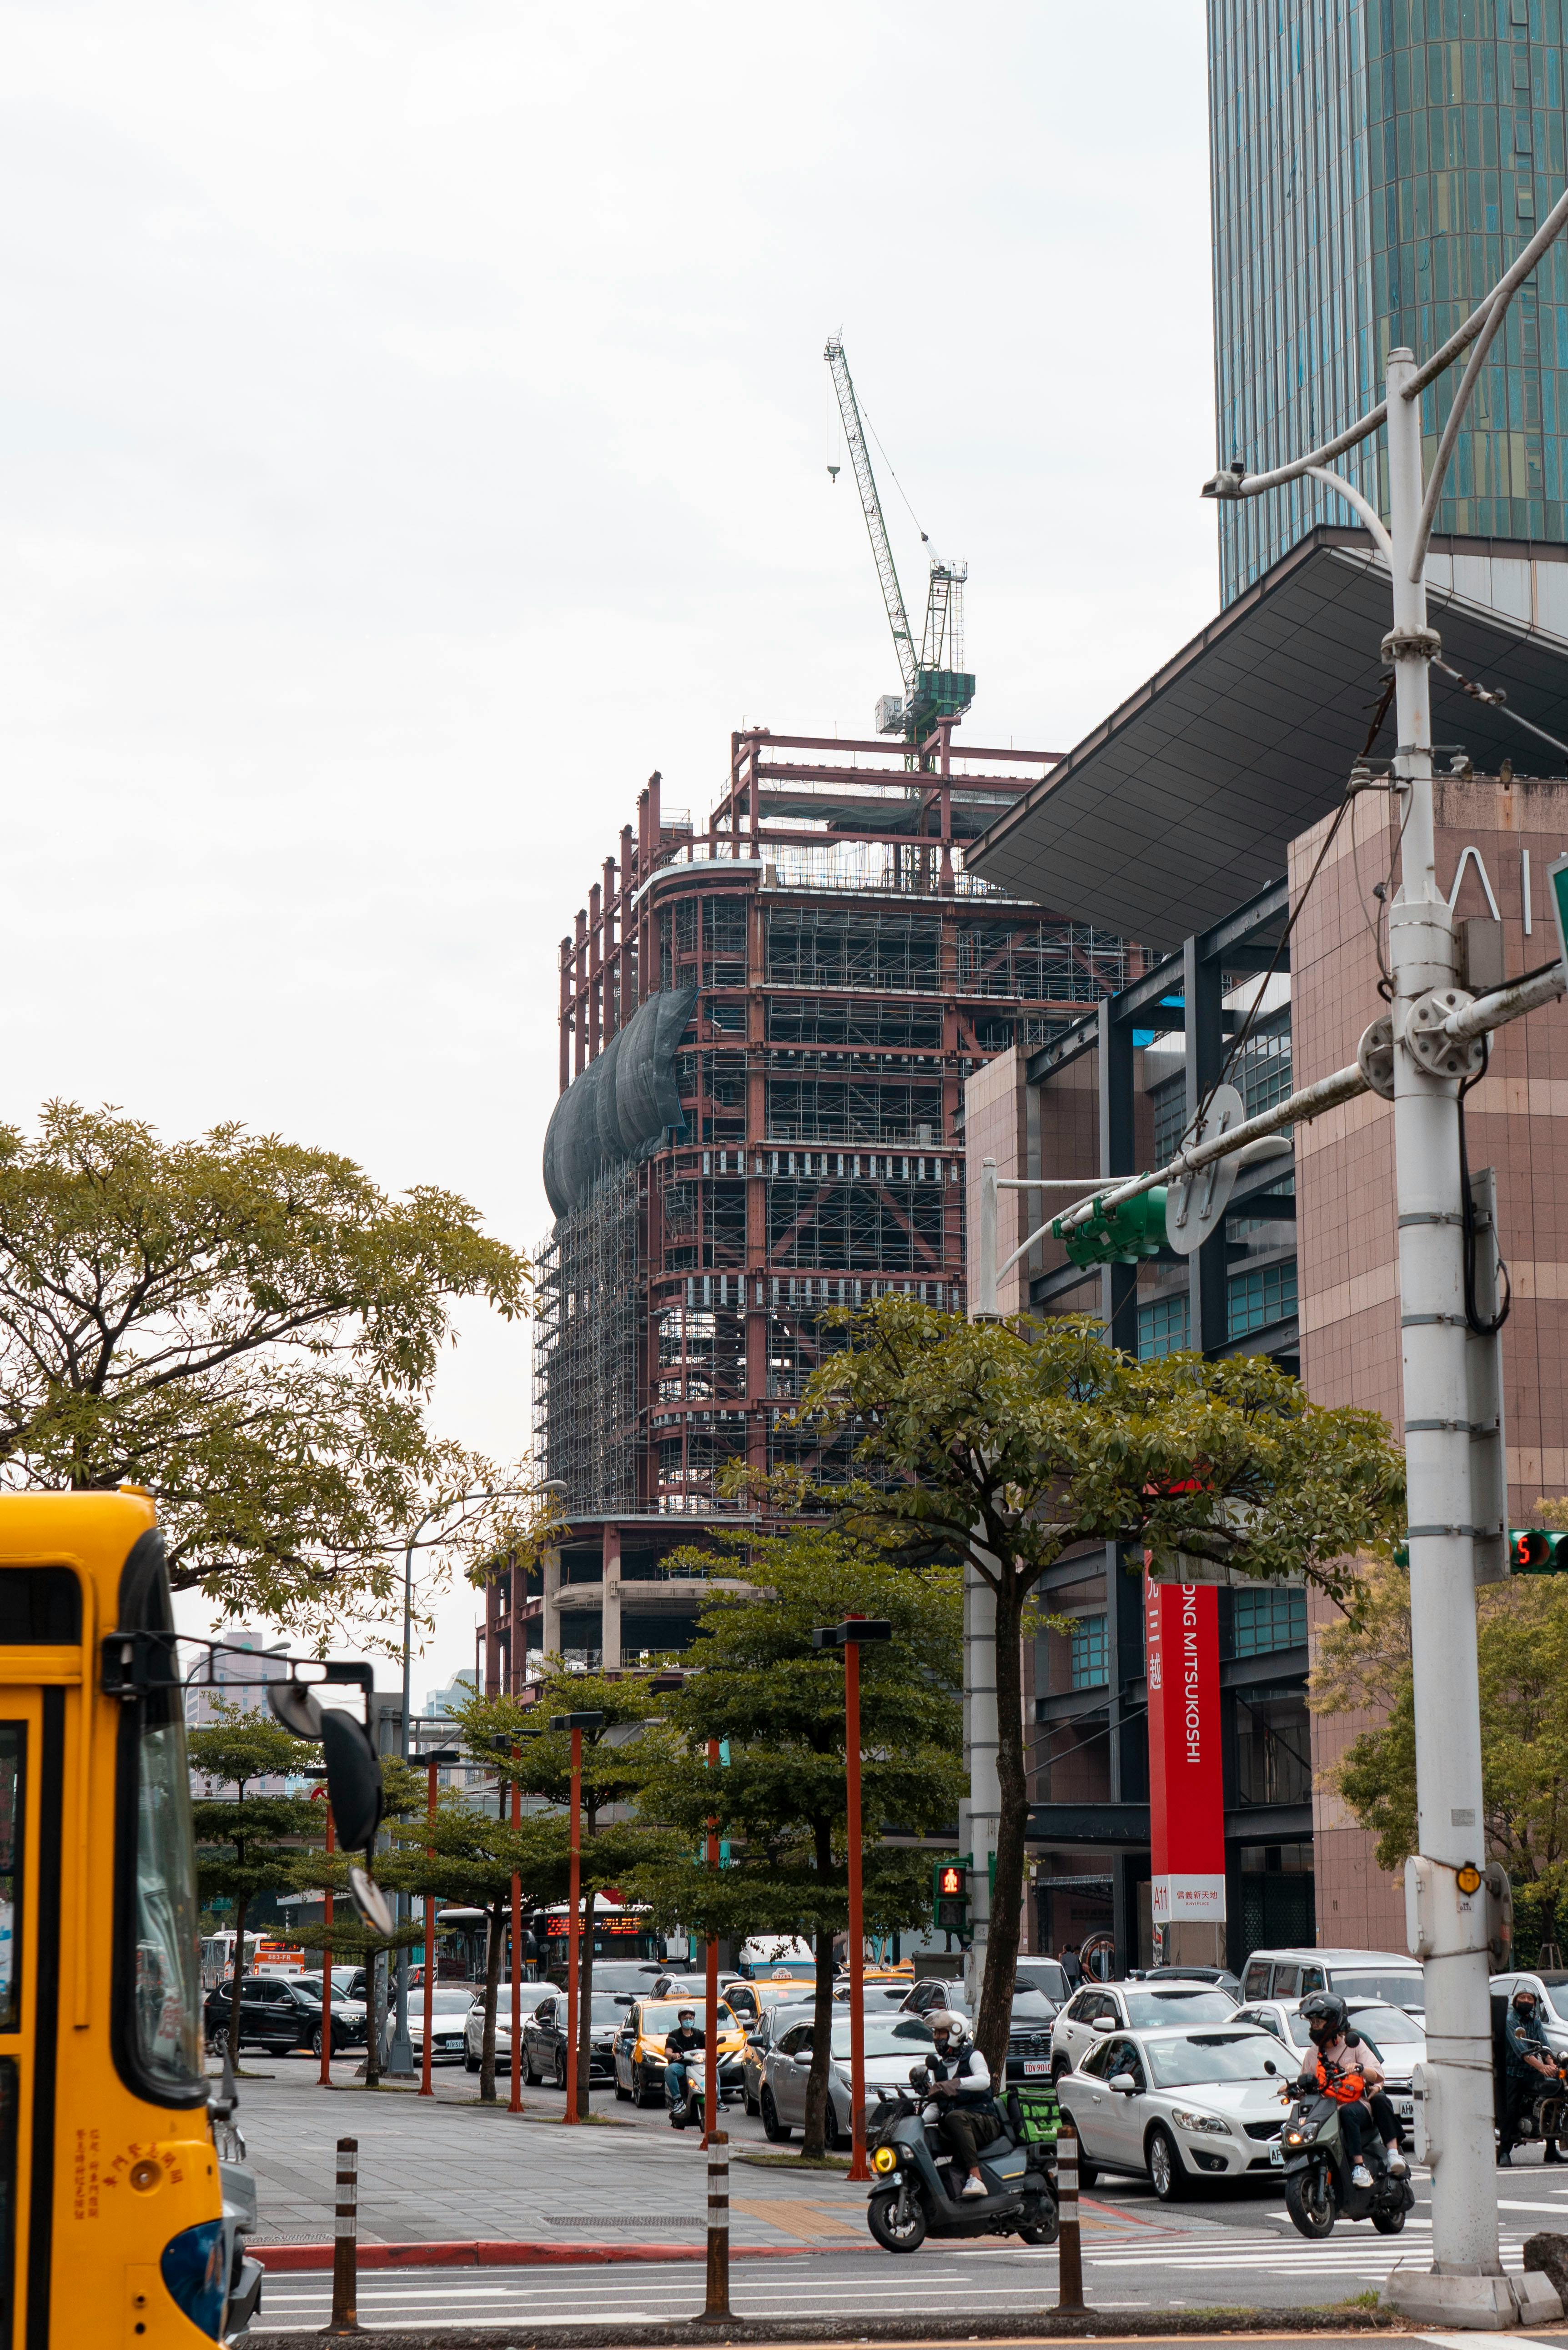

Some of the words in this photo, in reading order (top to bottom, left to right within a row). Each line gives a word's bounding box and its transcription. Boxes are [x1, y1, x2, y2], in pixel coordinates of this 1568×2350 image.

[1517, 1537, 1530, 1564] 5
[1184, 1632, 1201, 1763] MITSUKOSHI
[1154, 1886, 1167, 1910] A11
[1176, 1890, 1218, 1900] 信義新天地
